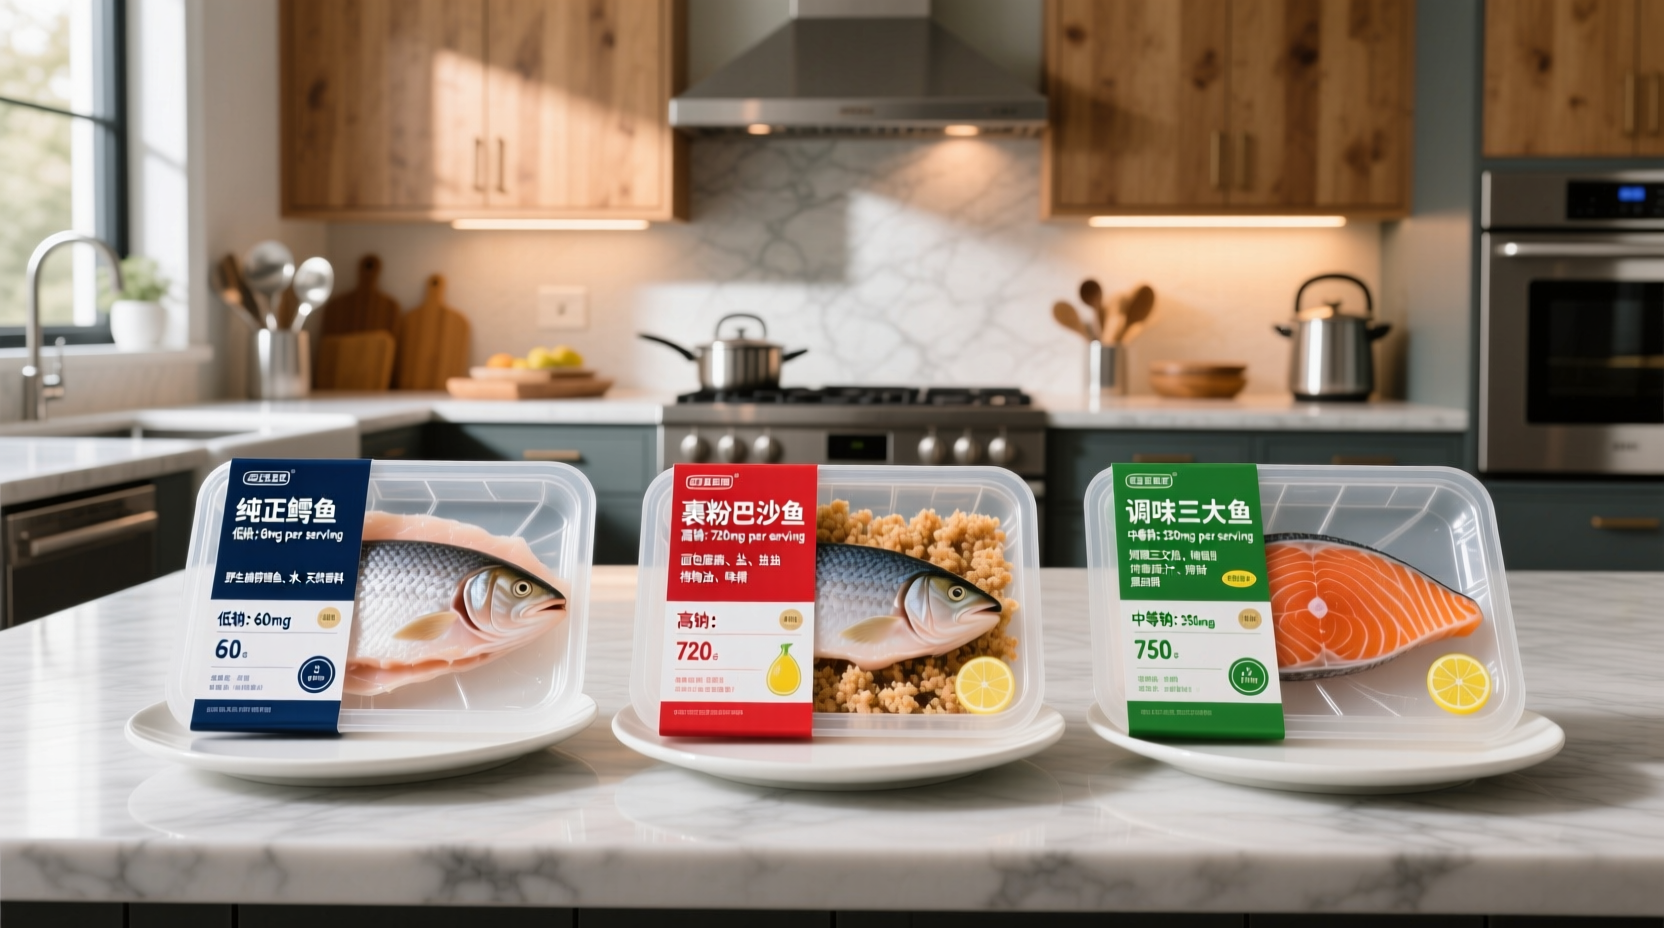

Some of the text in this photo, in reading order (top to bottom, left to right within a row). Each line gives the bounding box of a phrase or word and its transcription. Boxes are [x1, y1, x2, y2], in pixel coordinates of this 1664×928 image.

[1125, 498, 1253, 525] 调味三大鱼
[285, 531, 303, 543] per
[305, 529, 344, 543] serving
[1198, 532, 1216, 544] per
[1217, 531, 1254, 544] serving
[254, 611, 292, 630] 60mg
[215, 638, 241, 659] 60
[676, 641, 712, 661] 720
[1134, 639, 1172, 660] 750
